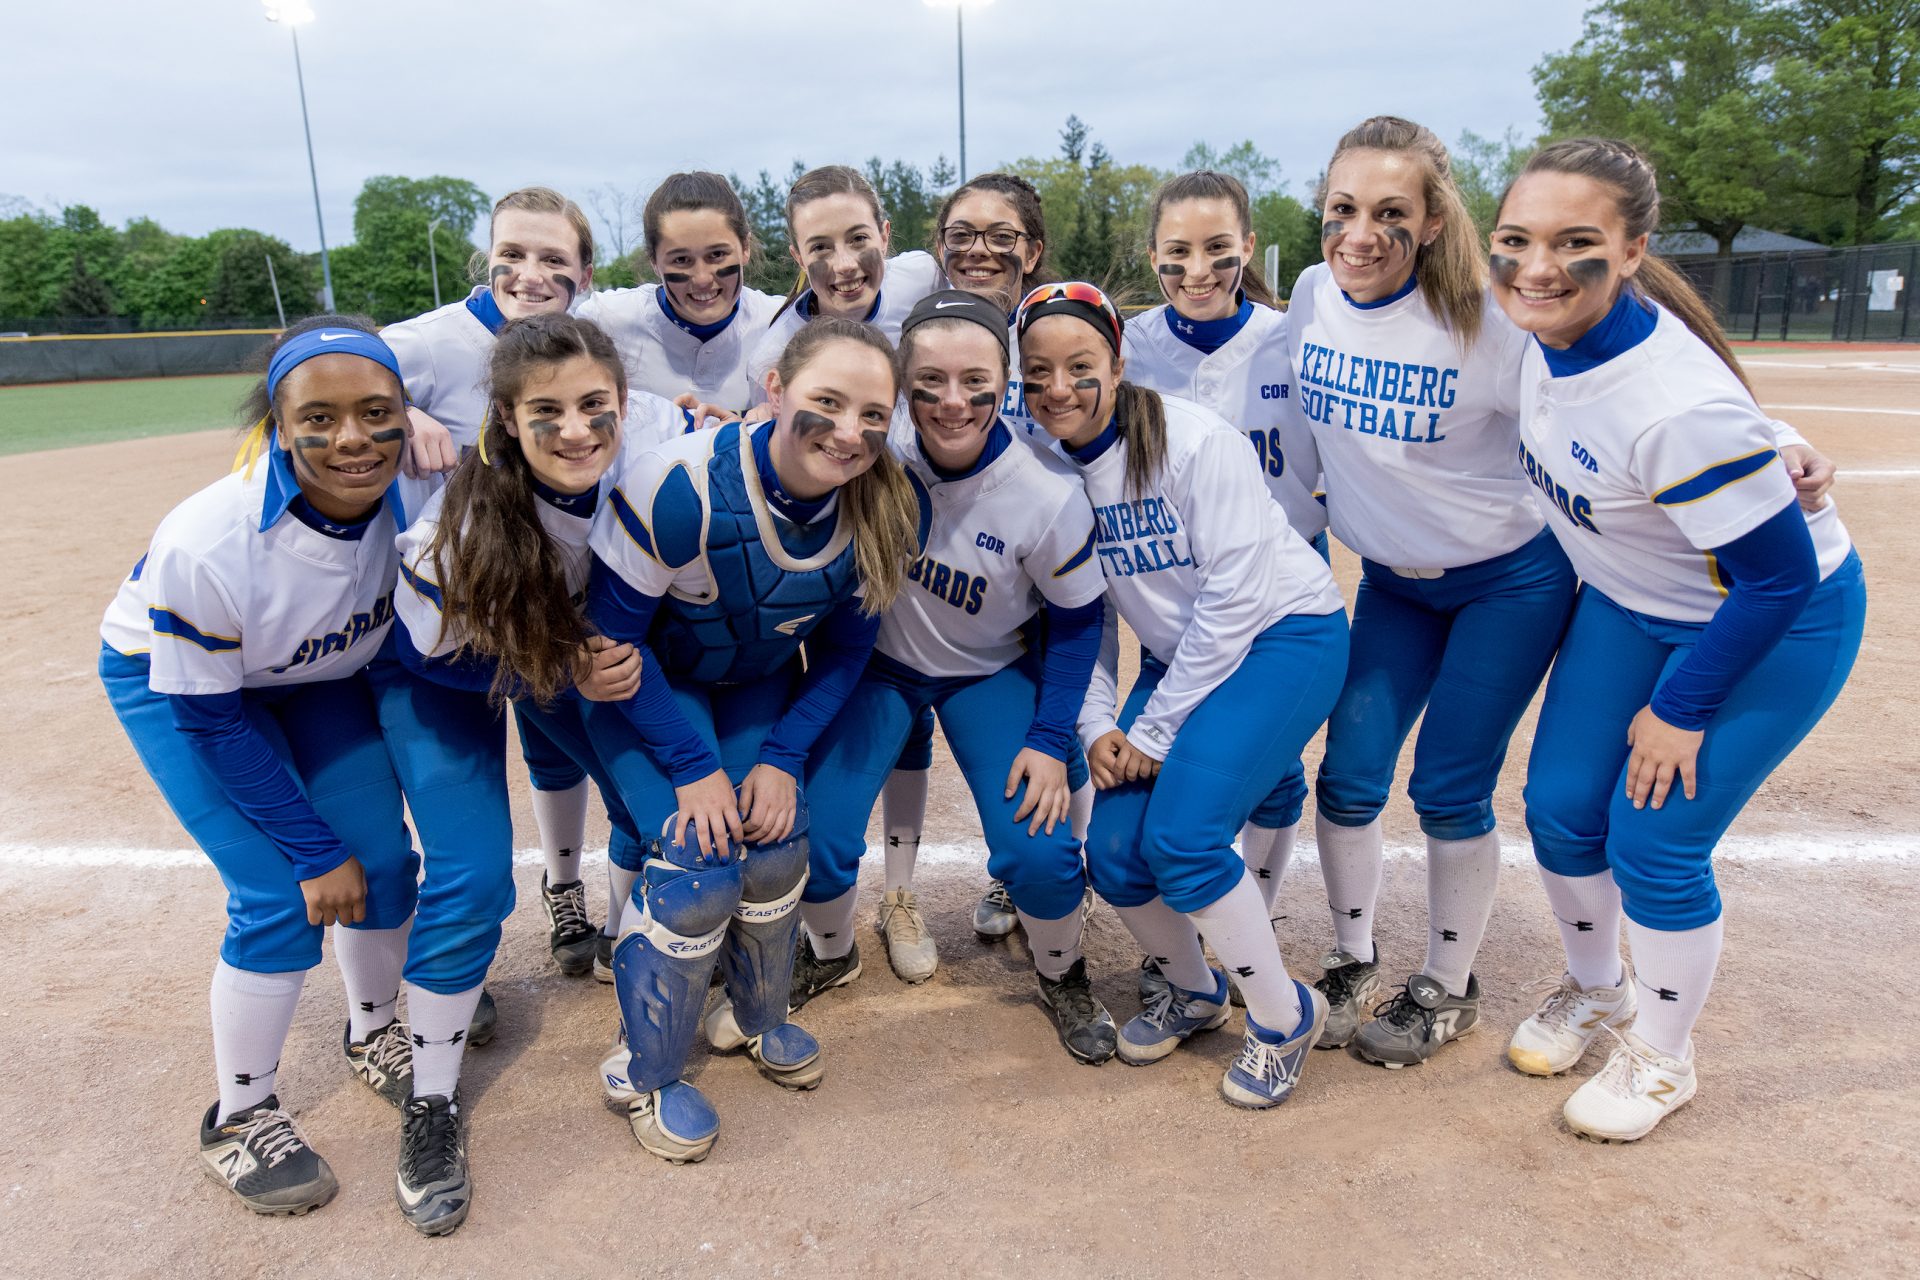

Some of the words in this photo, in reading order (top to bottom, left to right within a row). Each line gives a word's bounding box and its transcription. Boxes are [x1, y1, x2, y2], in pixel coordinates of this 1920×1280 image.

[1300, 342, 1459, 409] KELLENBERG
[1260, 384, 1290, 400] COR
[1301, 385, 1446, 443] SOFTBALL
[1571, 440, 1599, 474] COR
[975, 531, 1006, 556] COR
[745, 898, 797, 917] EASTON
